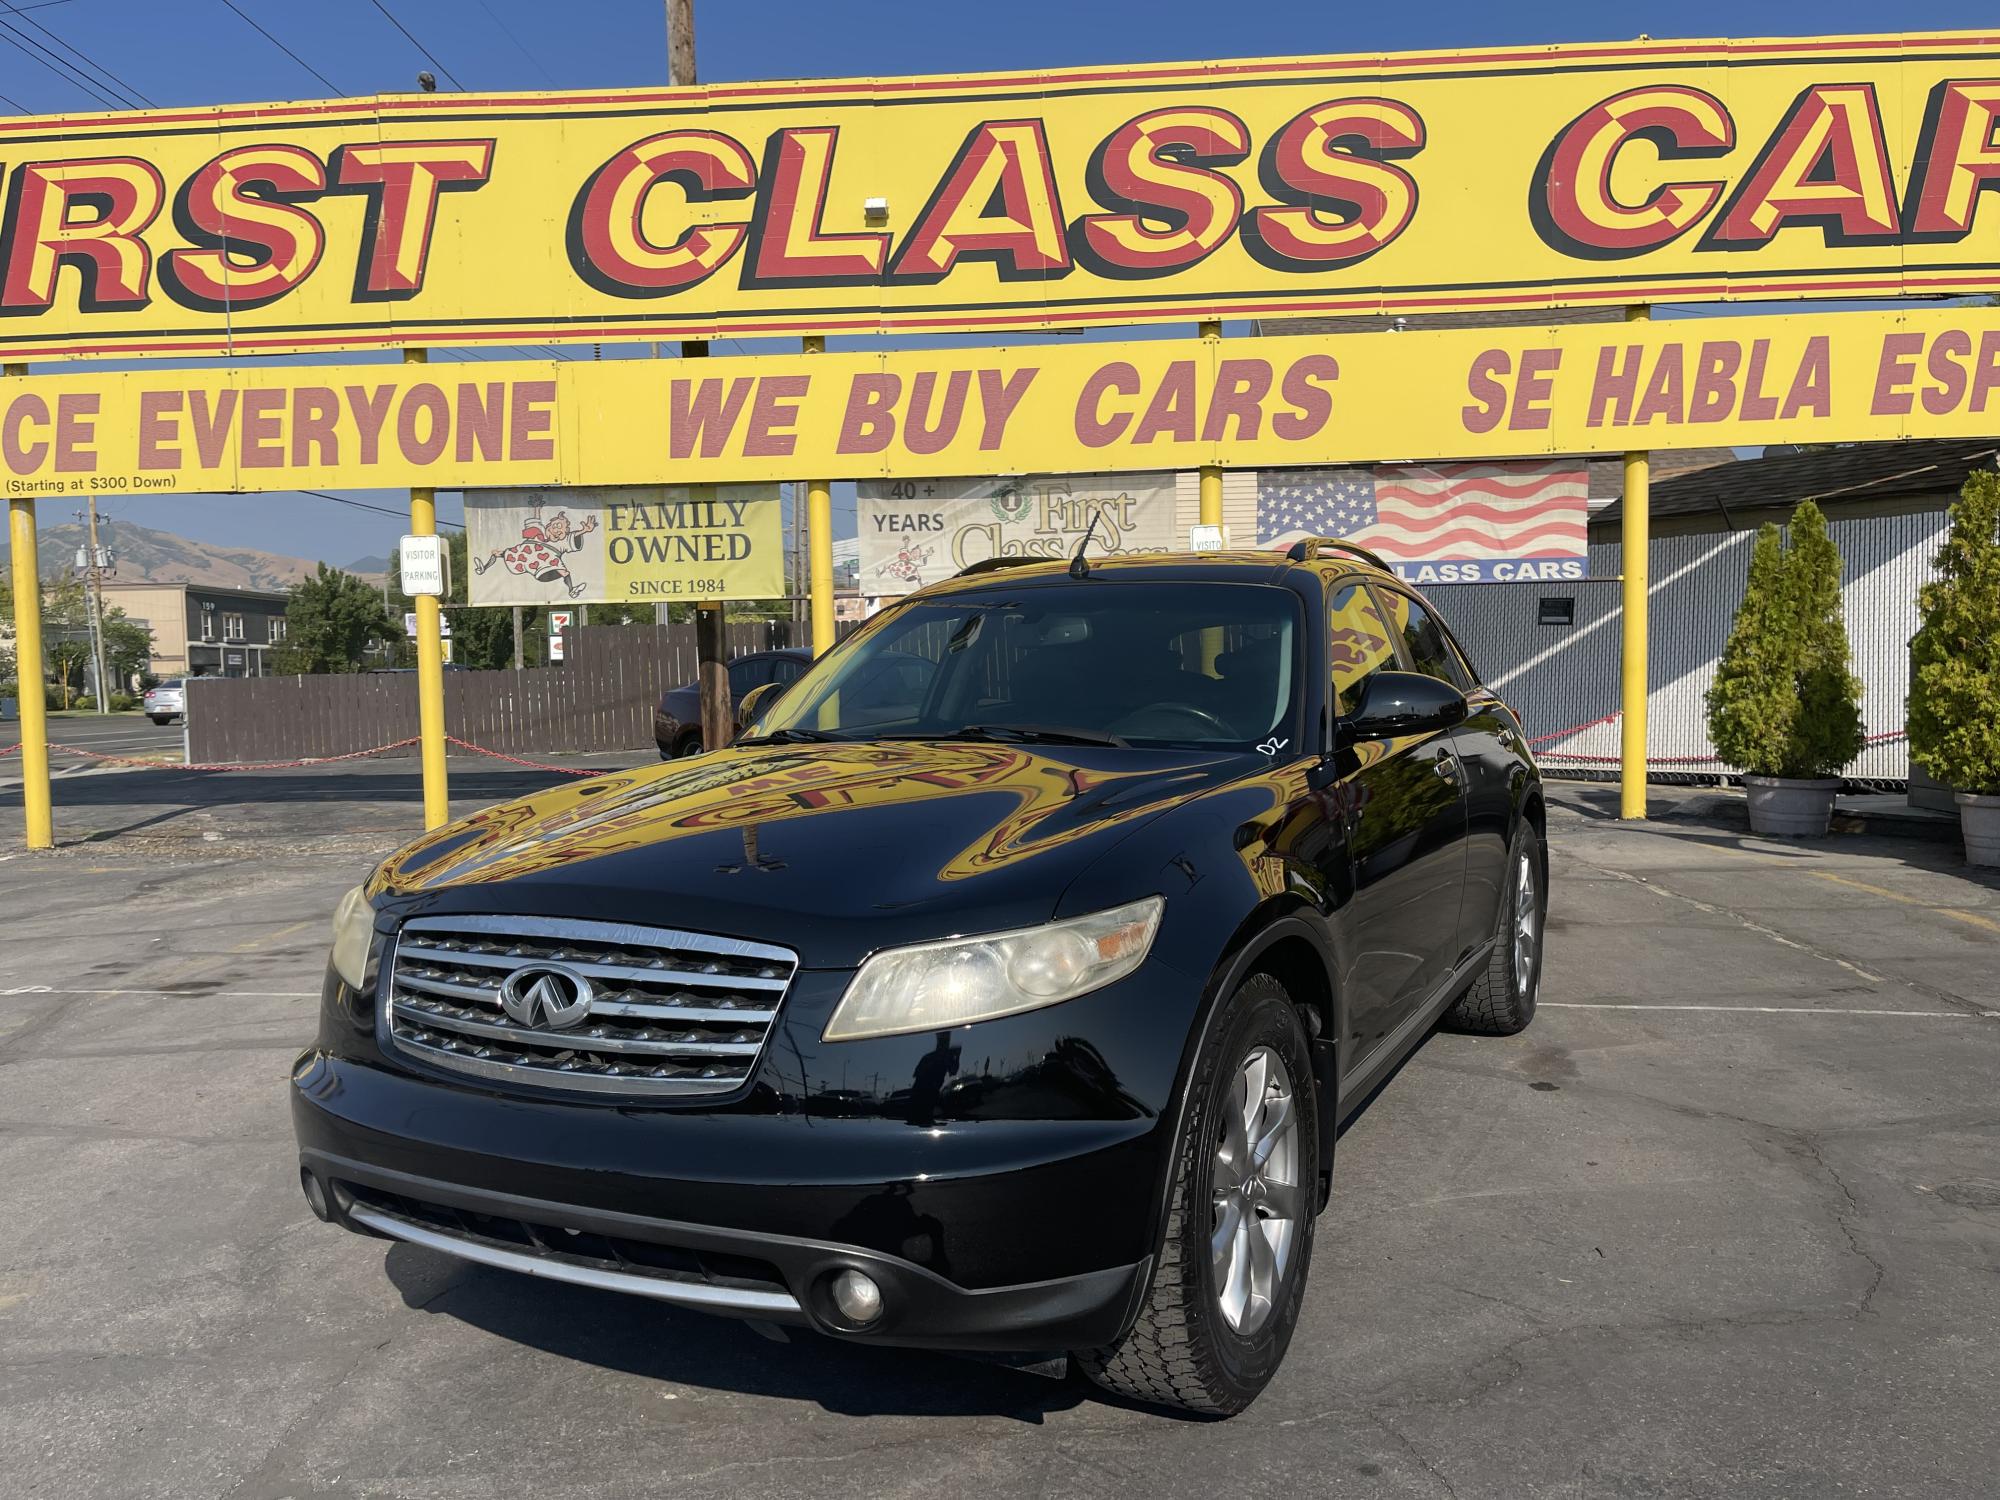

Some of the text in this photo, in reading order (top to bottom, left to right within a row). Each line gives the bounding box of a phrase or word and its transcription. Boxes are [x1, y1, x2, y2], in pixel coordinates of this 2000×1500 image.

[0, 138, 497, 317] RST
[565, 96, 1426, 300] CLASS
[138, 381, 557, 470] EVERYONE
[669, 374, 812, 459] WE
[836, 367, 1040, 455] BUY
[1074, 354, 1340, 448] CARS
[1461, 347, 1563, 434] SE
[1585, 335, 1831, 428] HABLA
[6, 474, 177, 493] (Starting at $300 Down)
[890, 481, 916, 500] 40
[607, 499, 749, 531] FAMILY
[872, 513, 944, 532] YEARS
[1032, 482, 1137, 550] First
[405, 550, 436, 560] VISITOR
[609, 533, 752, 564] OWNED
[404, 571, 438, 581] PARKING
[1393, 561, 1582, 583] LASS CARS
[629, 578, 726, 595] SINCE 1984
